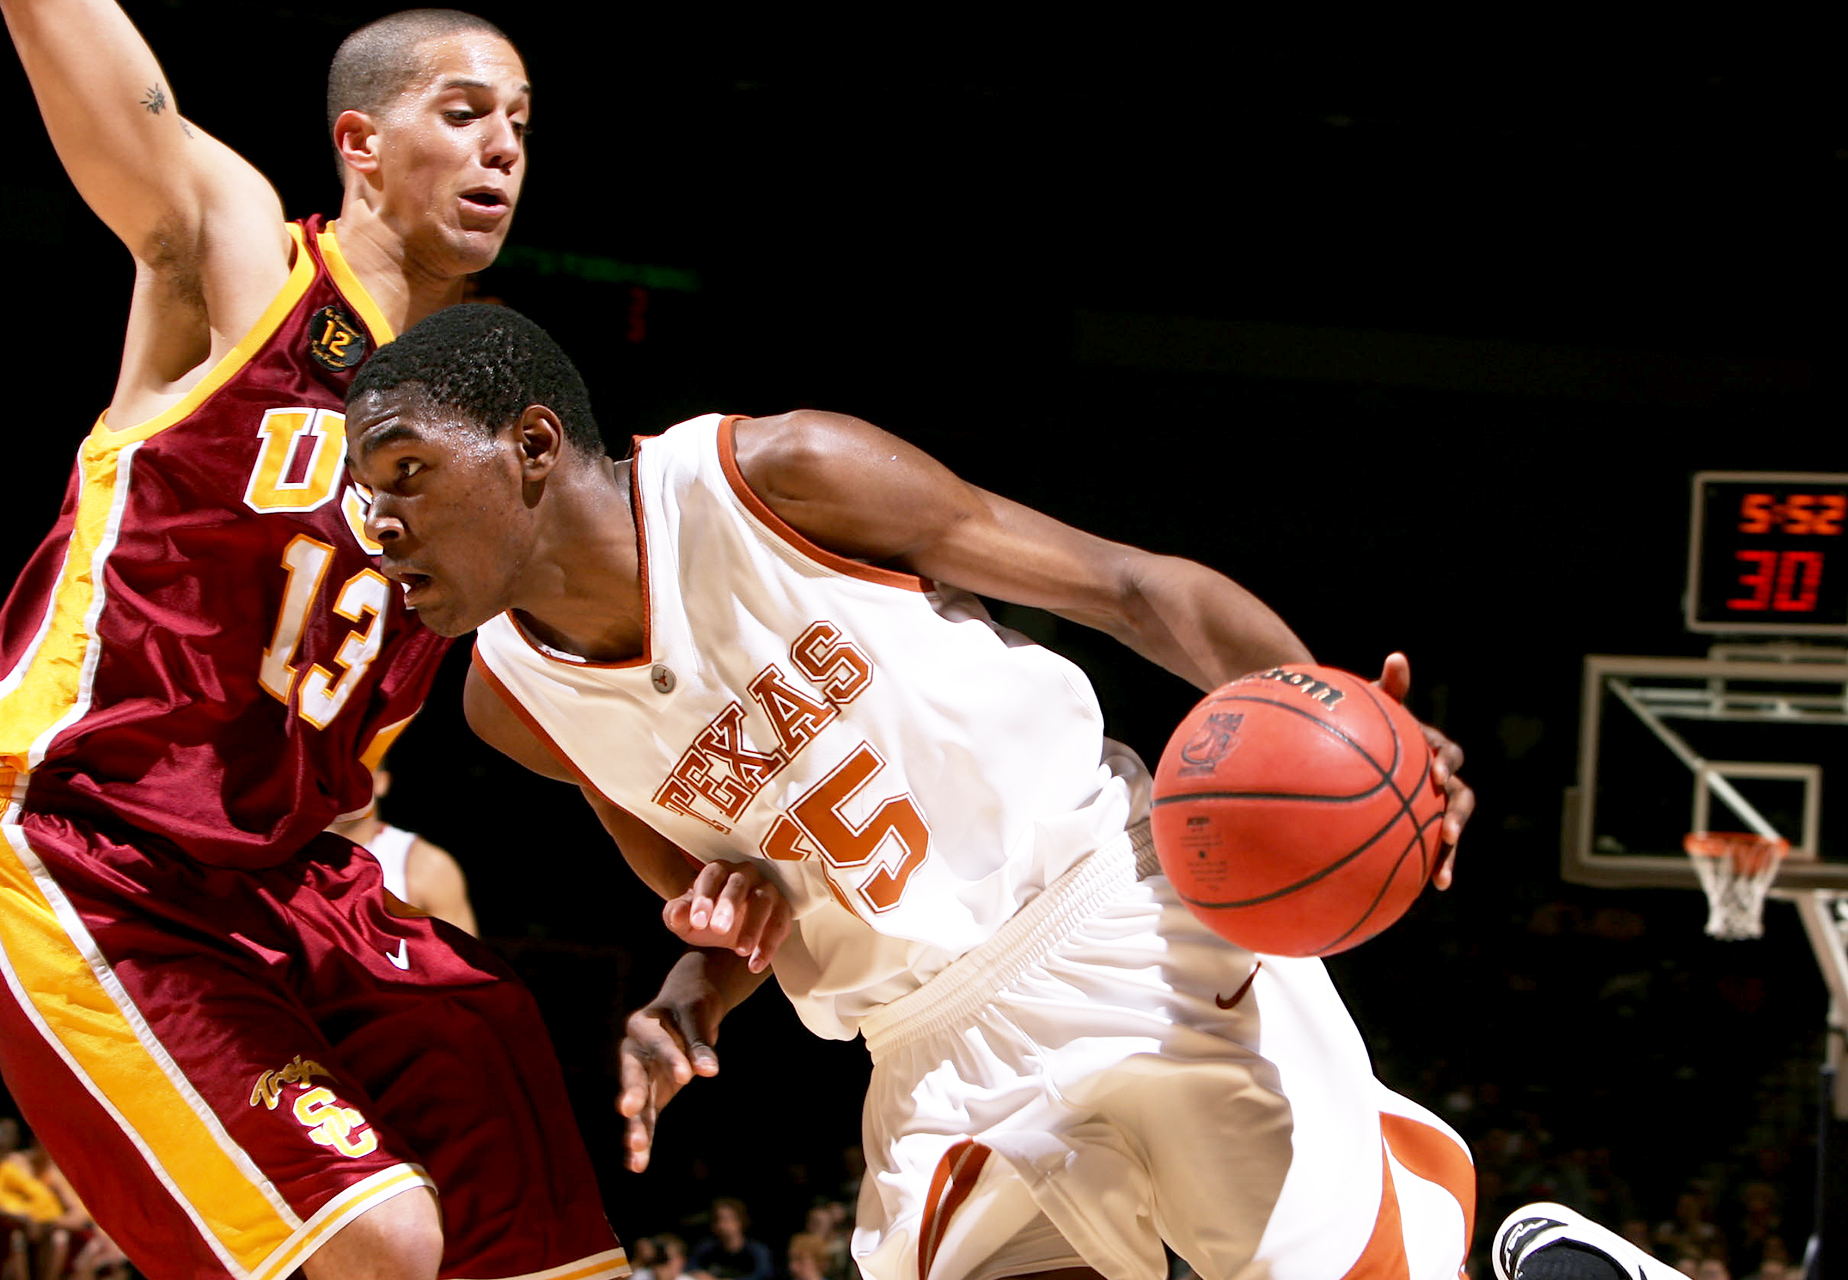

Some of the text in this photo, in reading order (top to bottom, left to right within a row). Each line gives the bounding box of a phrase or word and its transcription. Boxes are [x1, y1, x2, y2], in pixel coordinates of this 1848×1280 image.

[320, 319, 352, 358] 12
[258, 533, 391, 732] 13
[1725, 550, 1826, 612] 30
[651, 620, 874, 835] TEXAS
